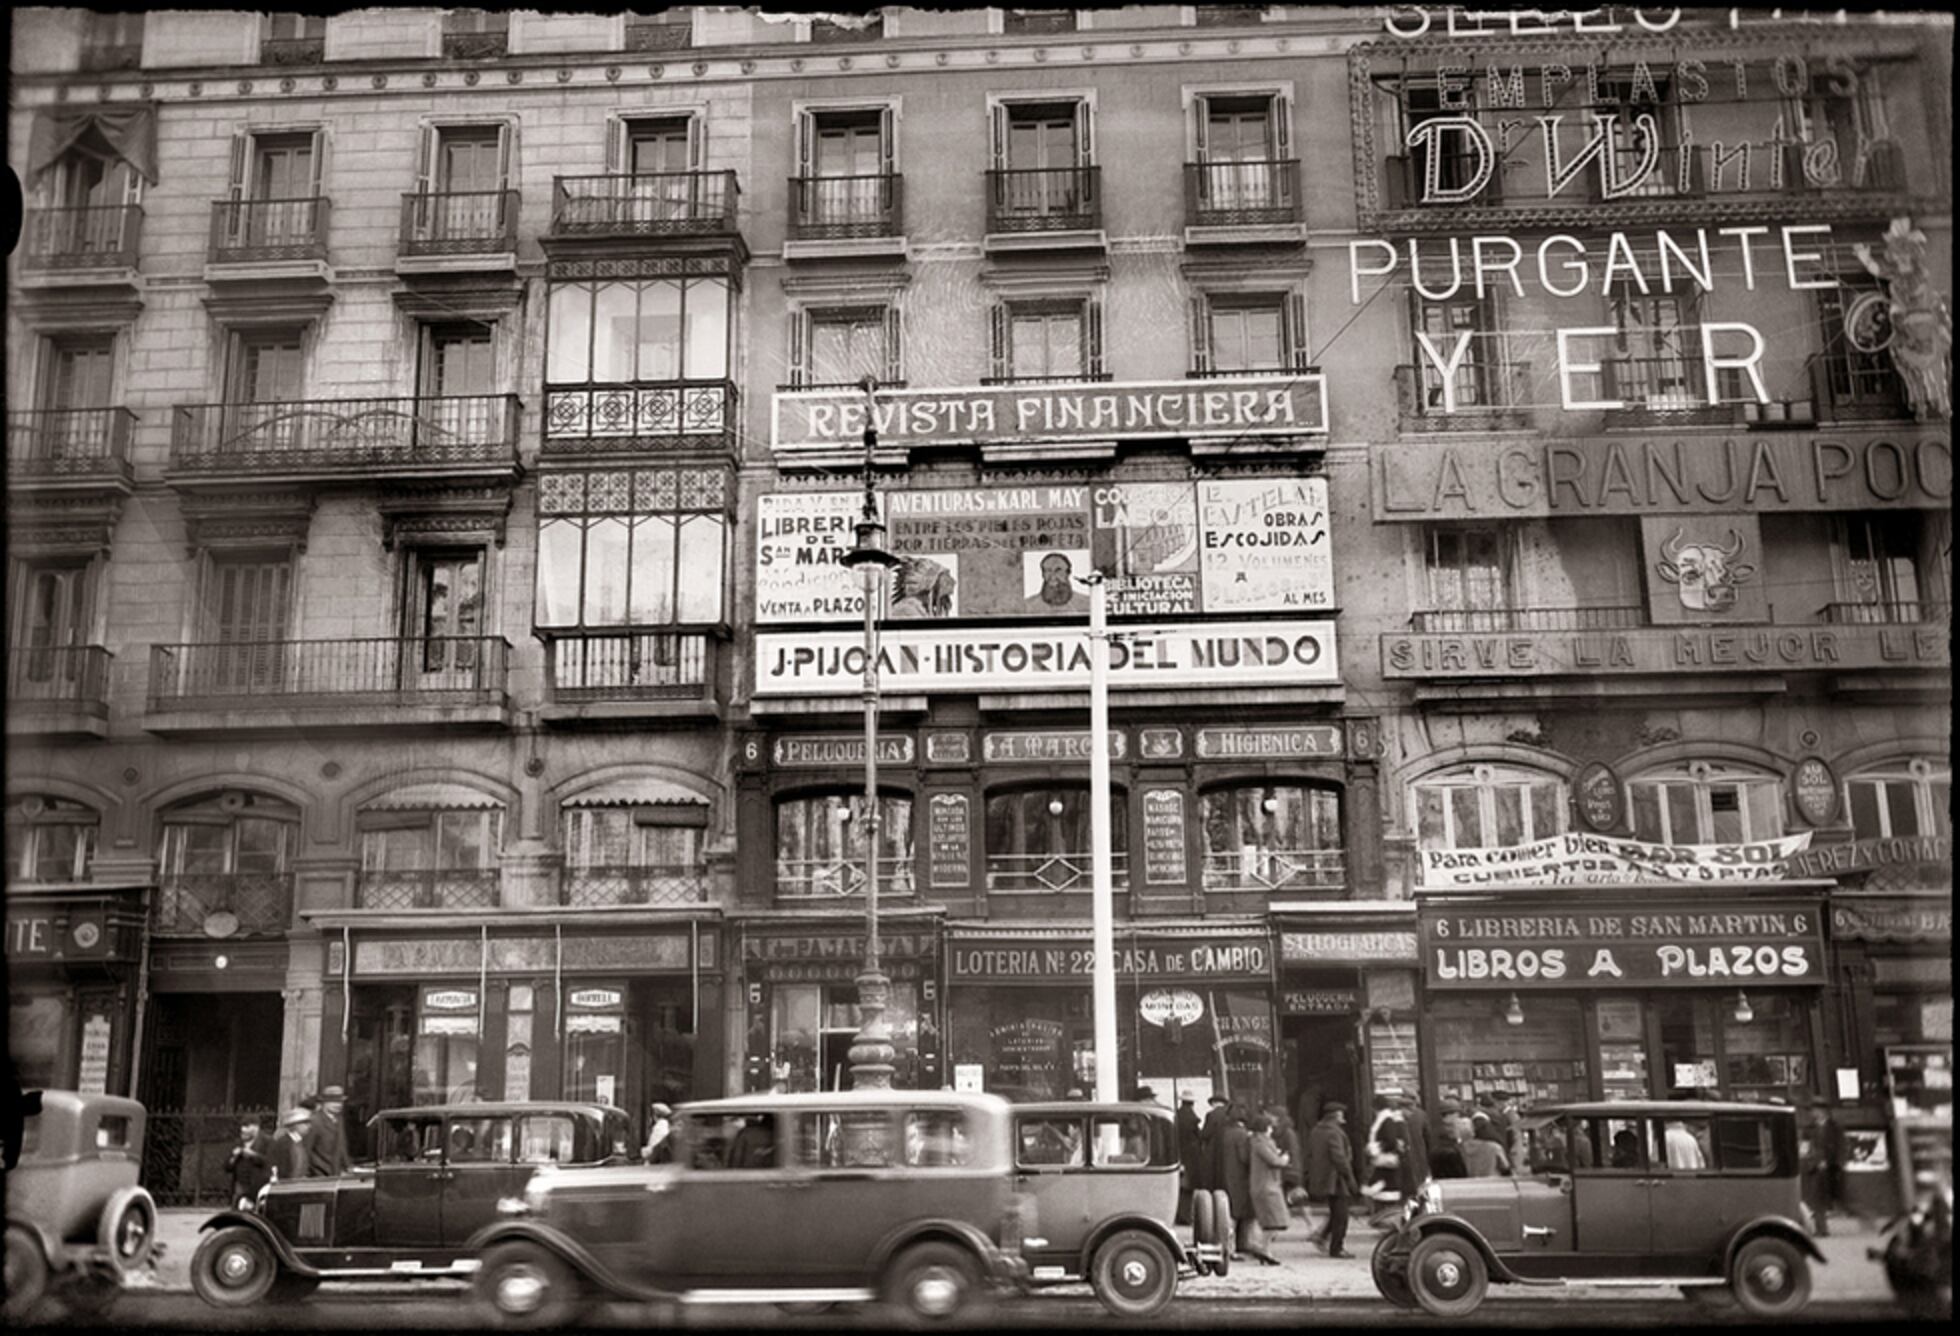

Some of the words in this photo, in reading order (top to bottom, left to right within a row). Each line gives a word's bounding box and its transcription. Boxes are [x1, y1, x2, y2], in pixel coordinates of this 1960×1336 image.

[1437, 53, 1859, 109] EMPLASTOS
[1349, 224, 1839, 304] PURGANTE
[806, 398, 995, 438] REVISTA
[1015, 388, 1295, 431] FINANCIERA
[1382, 446, 1476, 512] LA
[1497, 438, 1789, 510] GRANJA
[891, 491, 985, 513] AVENTURAS
[761, 515, 855, 539] LIBRERI
[1263, 511, 1323, 528] OBRAS
[805, 535, 836, 545] DE
[1205, 530, 1325, 549] ESCOJIDAS
[795, 547, 851, 566] MAR
[1104, 576, 1193, 591] BIBLIOTECA
[760, 600, 801, 616] VENTA
[813, 597, 866, 613] PLAZO
[1283, 593, 1299, 605] AL
[1302, 591, 1327, 604] MES
[934, 642, 1092, 674] HISTORIA
[1108, 639, 1178, 670] DEL
[1190, 634, 1321, 668] MUNDO
[1389, 637, 1537, 671] SIRVE
[1572, 636, 1636, 667] LA
[1674, 631, 1840, 666] MEJOR
[1221, 732, 1317, 753] HIGIENICA
[1355, 729, 1369, 748] 6
[745, 741, 758, 760] 6
[787, 741, 900, 762] PELUQUEIA
[1429, 850, 1481, 869] Para
[1485, 841, 1556, 864] comer
[1564, 832, 1610, 855] bien
[1710, 843, 1789, 865] SOL
[1798, 843, 1858, 876] JEREZ
[1453, 859, 1619, 884] CUBIERTOS
[13, 918, 48, 952] TE
[1436, 919, 1449, 936] 6
[1458, 917, 1580, 938] LIBRERIA
[1588, 916, 1623, 936] DE
[1630, 915, 1683, 936] SAN
[1794, 914, 1808, 933] 6
[799, 936, 914, 956] PAJARTA
[956, 950, 1040, 974] LOTERIA
[1165, 954, 1185, 972] DE
[1190, 947, 1264, 973] CAMBIO
[1437, 948, 1567, 979] LIBROS
[1588, 948, 1623, 977] A
[1656, 944, 1809, 977] PLAZOS
[1289, 1001, 1350, 1011] ENTRADA
